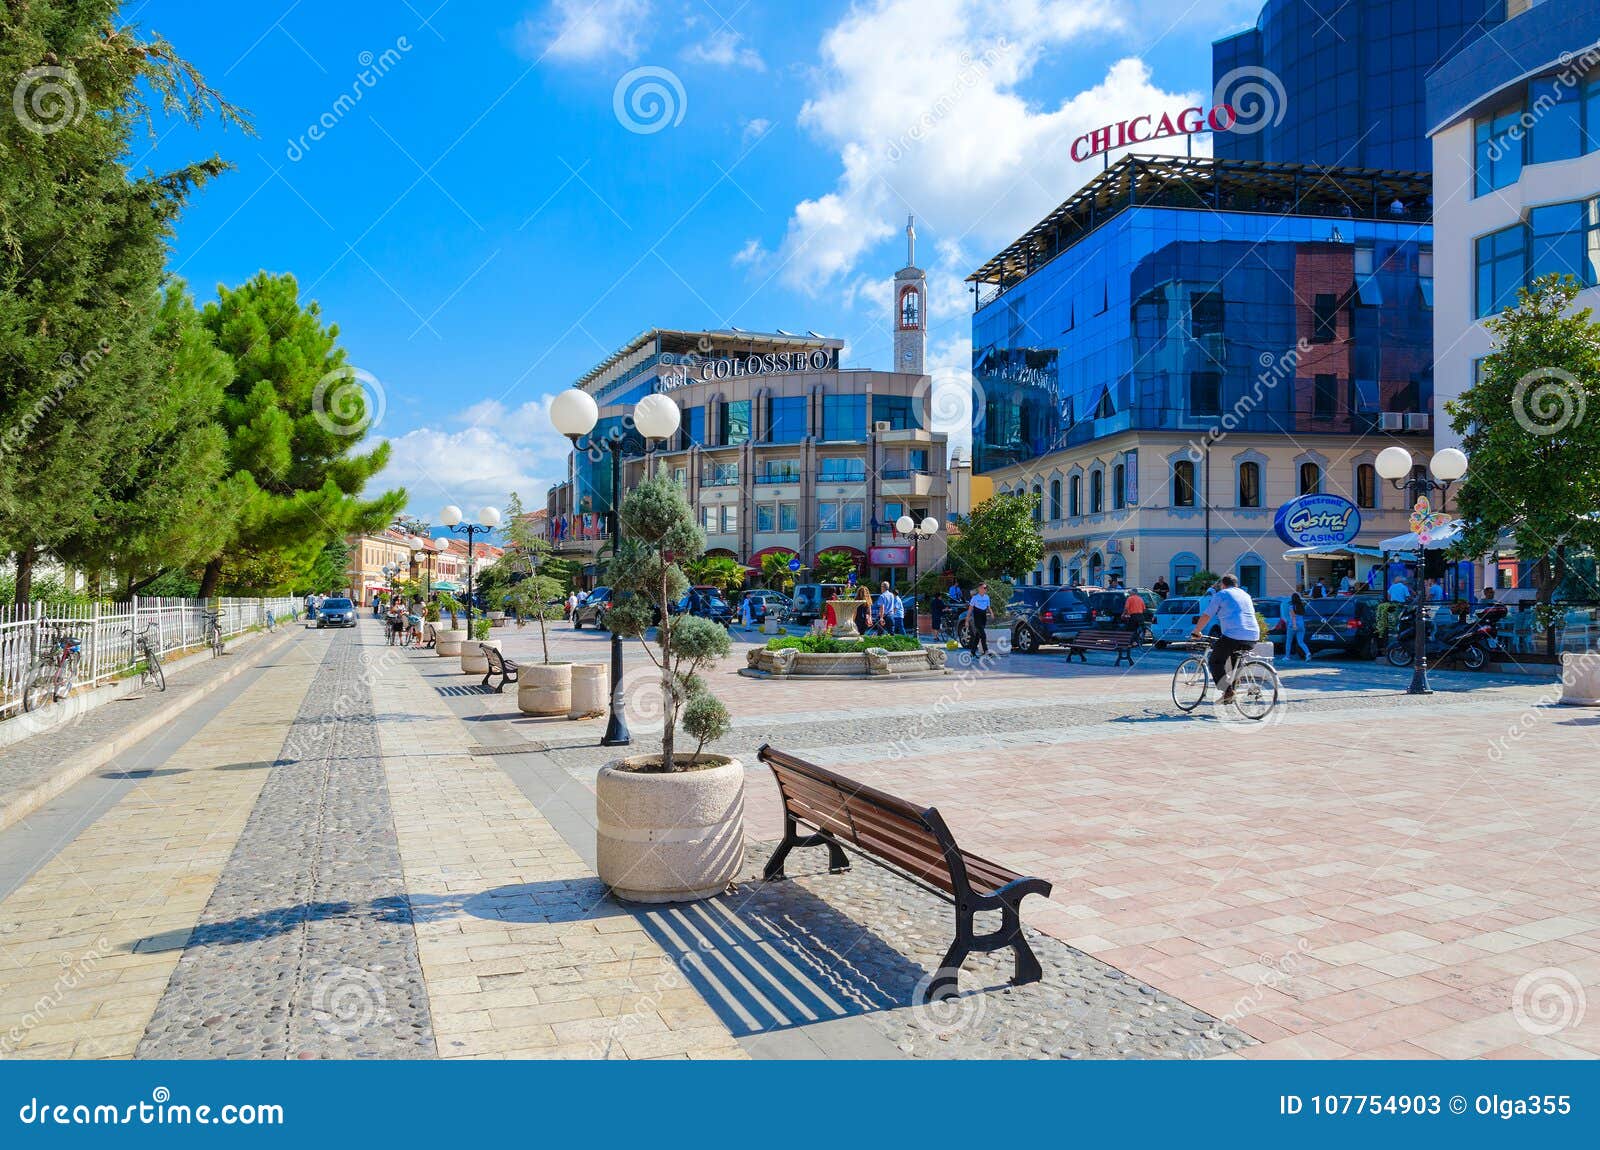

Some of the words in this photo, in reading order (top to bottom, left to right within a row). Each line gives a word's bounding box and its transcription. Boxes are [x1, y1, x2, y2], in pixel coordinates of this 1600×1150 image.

[1070, 103, 1236, 163] CHICAGO
[701, 350, 831, 381] COLOSSEO
[1300, 533, 1344, 542] CASINO
